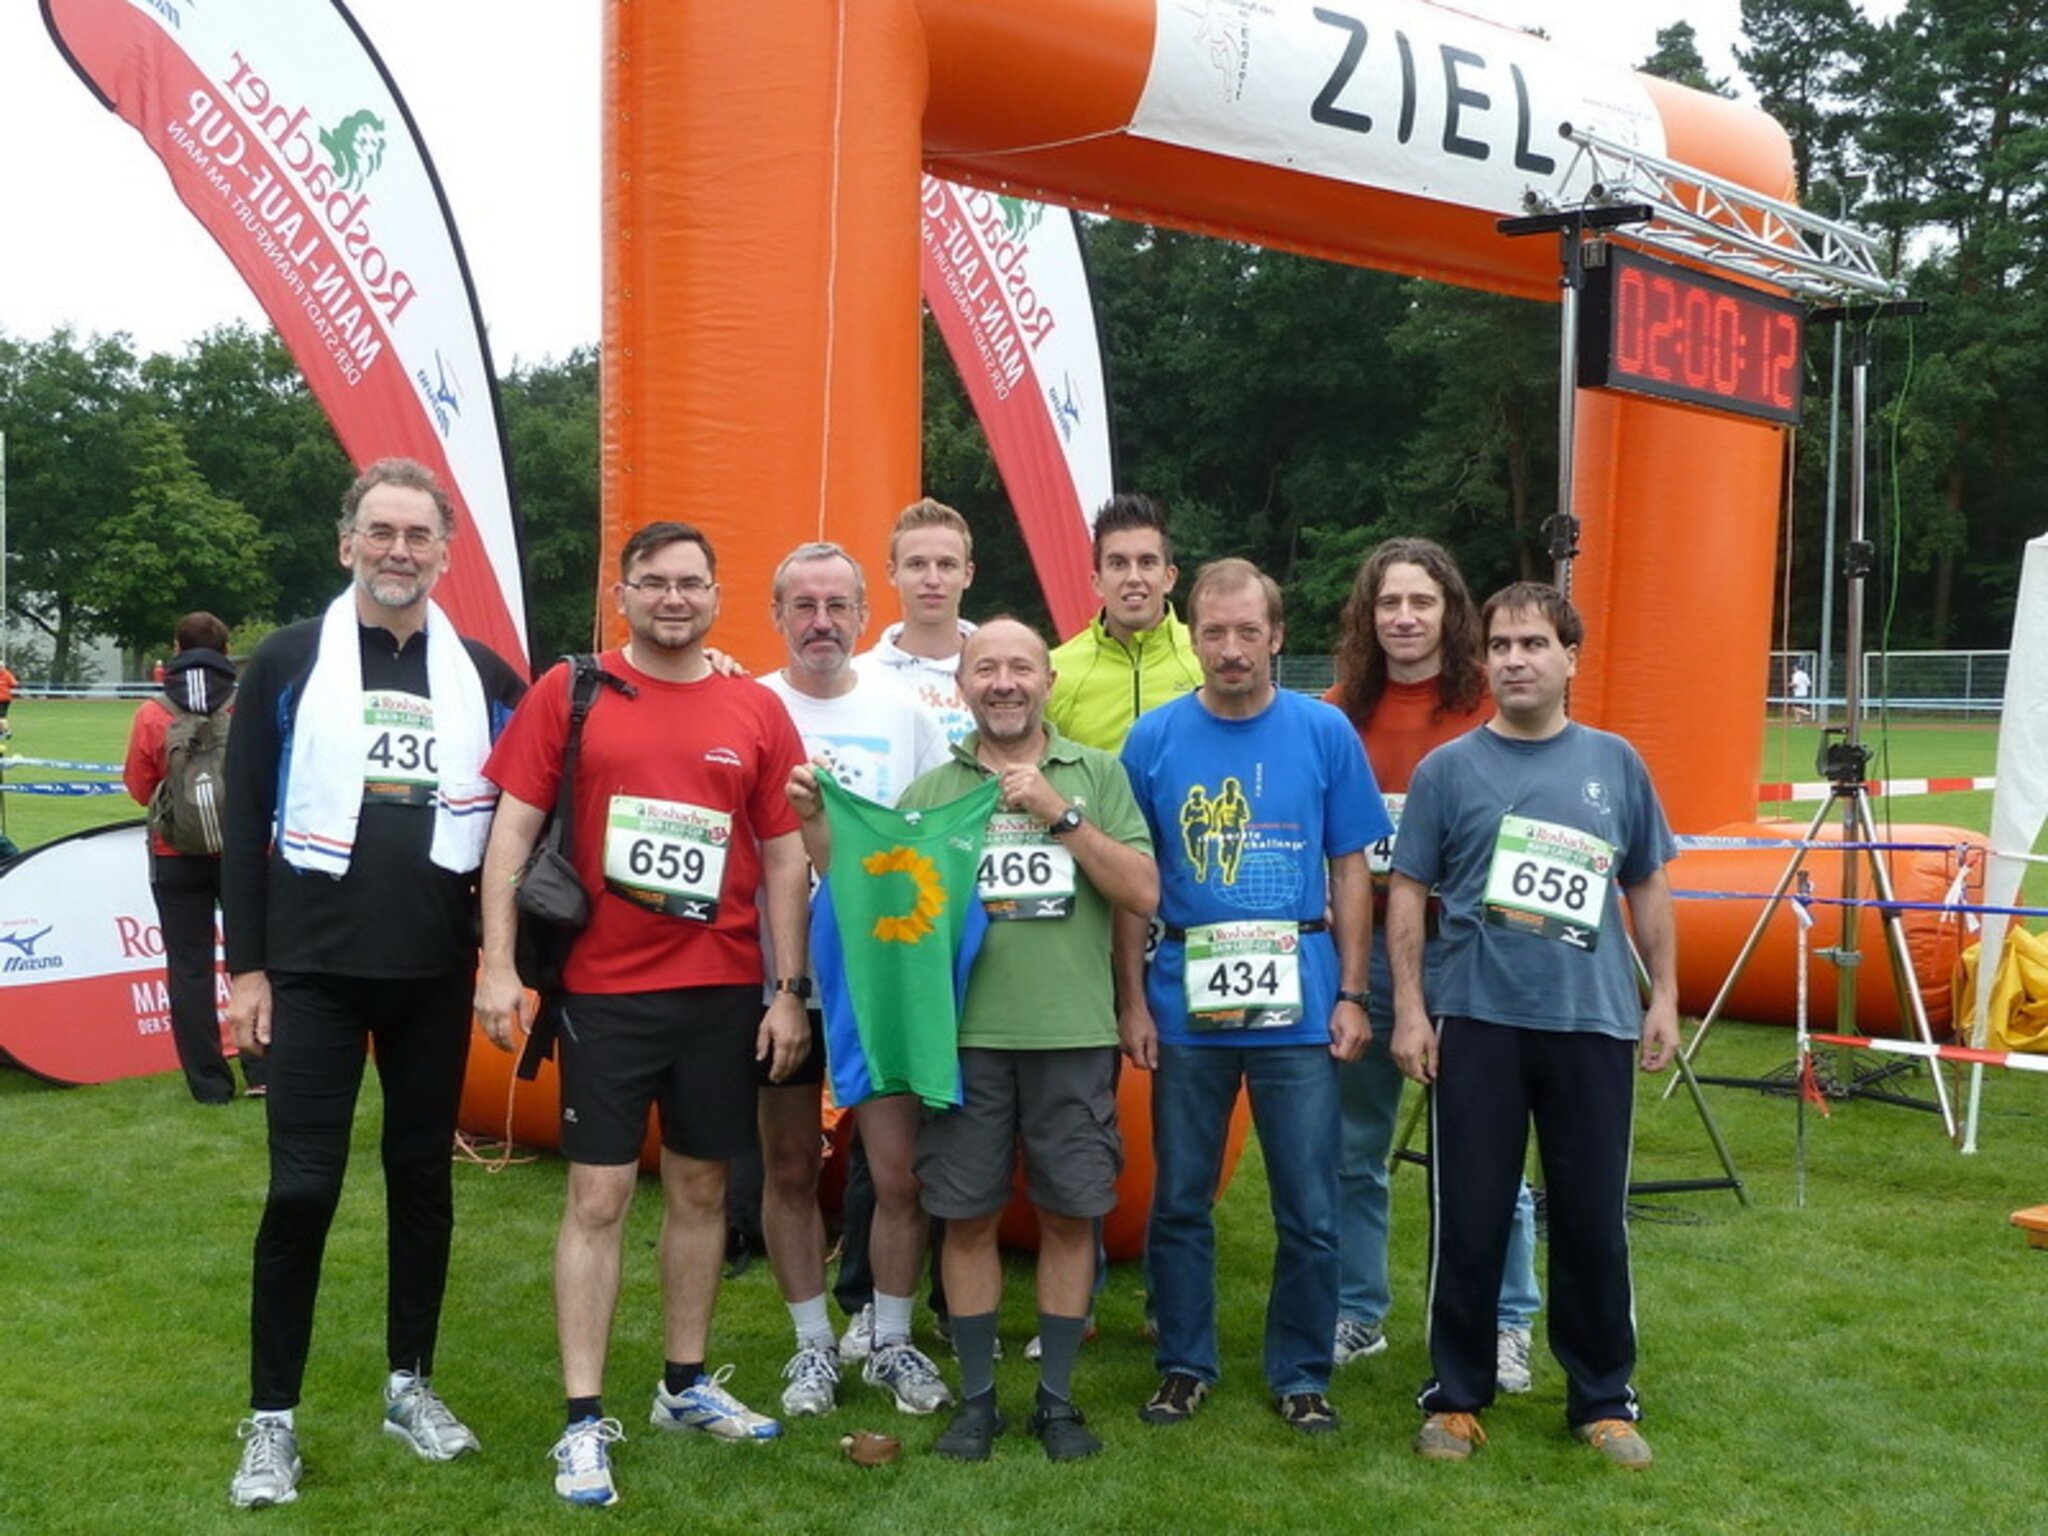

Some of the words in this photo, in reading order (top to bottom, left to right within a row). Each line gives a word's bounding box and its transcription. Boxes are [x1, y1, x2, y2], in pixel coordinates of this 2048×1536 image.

[1311, 6, 1555, 176] ZIEL
[1617, 267, 1797, 409] 02:00:12
[629, 838, 705, 884] 659
[978, 852, 1050, 888] 466
[1512, 861, 1588, 910] 658
[1208, 960, 1279, 997] 434
